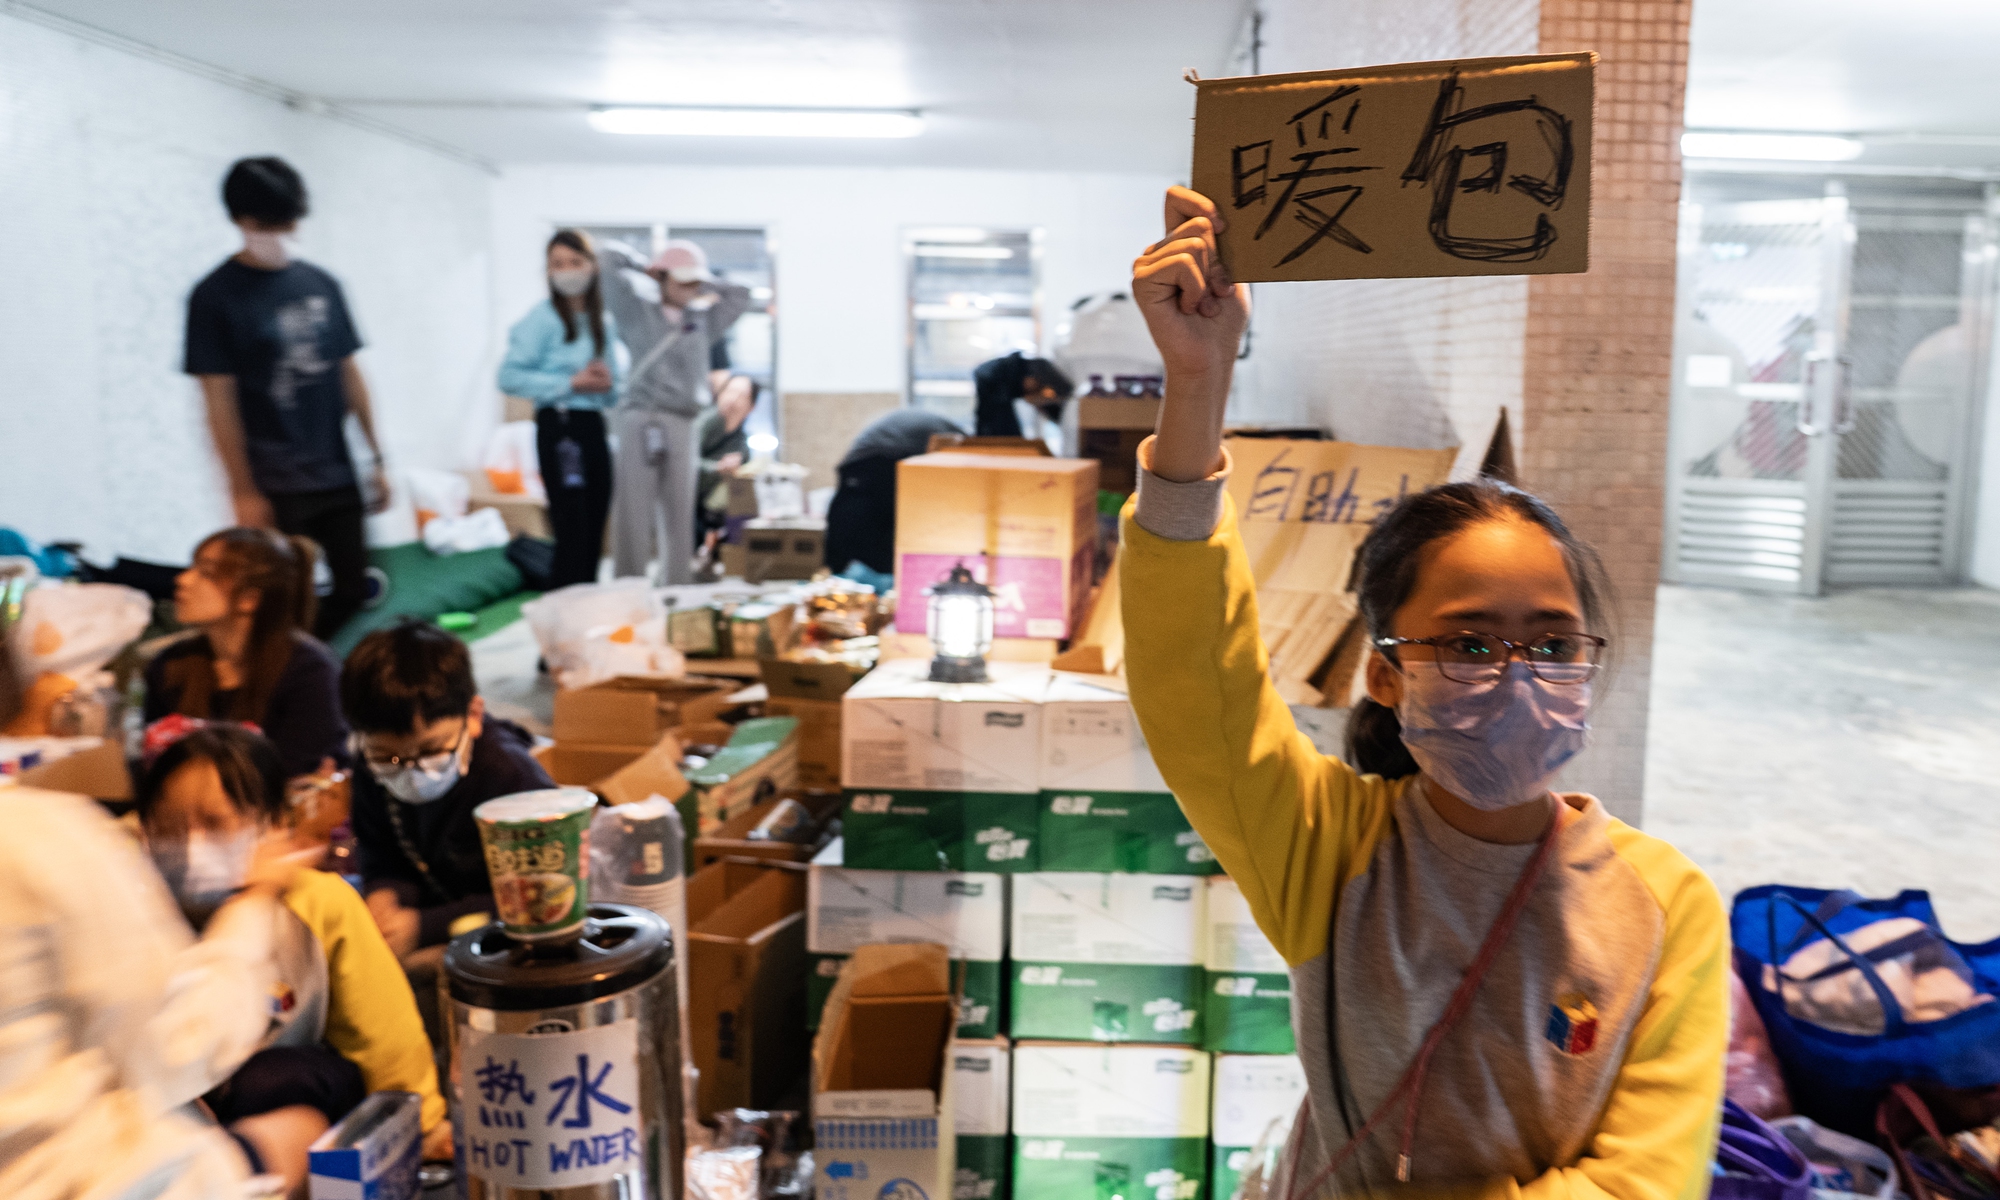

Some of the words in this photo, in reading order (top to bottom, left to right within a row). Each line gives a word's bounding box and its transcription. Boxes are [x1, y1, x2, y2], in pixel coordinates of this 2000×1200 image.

[1231, 66, 1574, 269] 暖包
[471, 1137, 532, 1175] HOT
[549, 1126, 638, 1173] WATER
